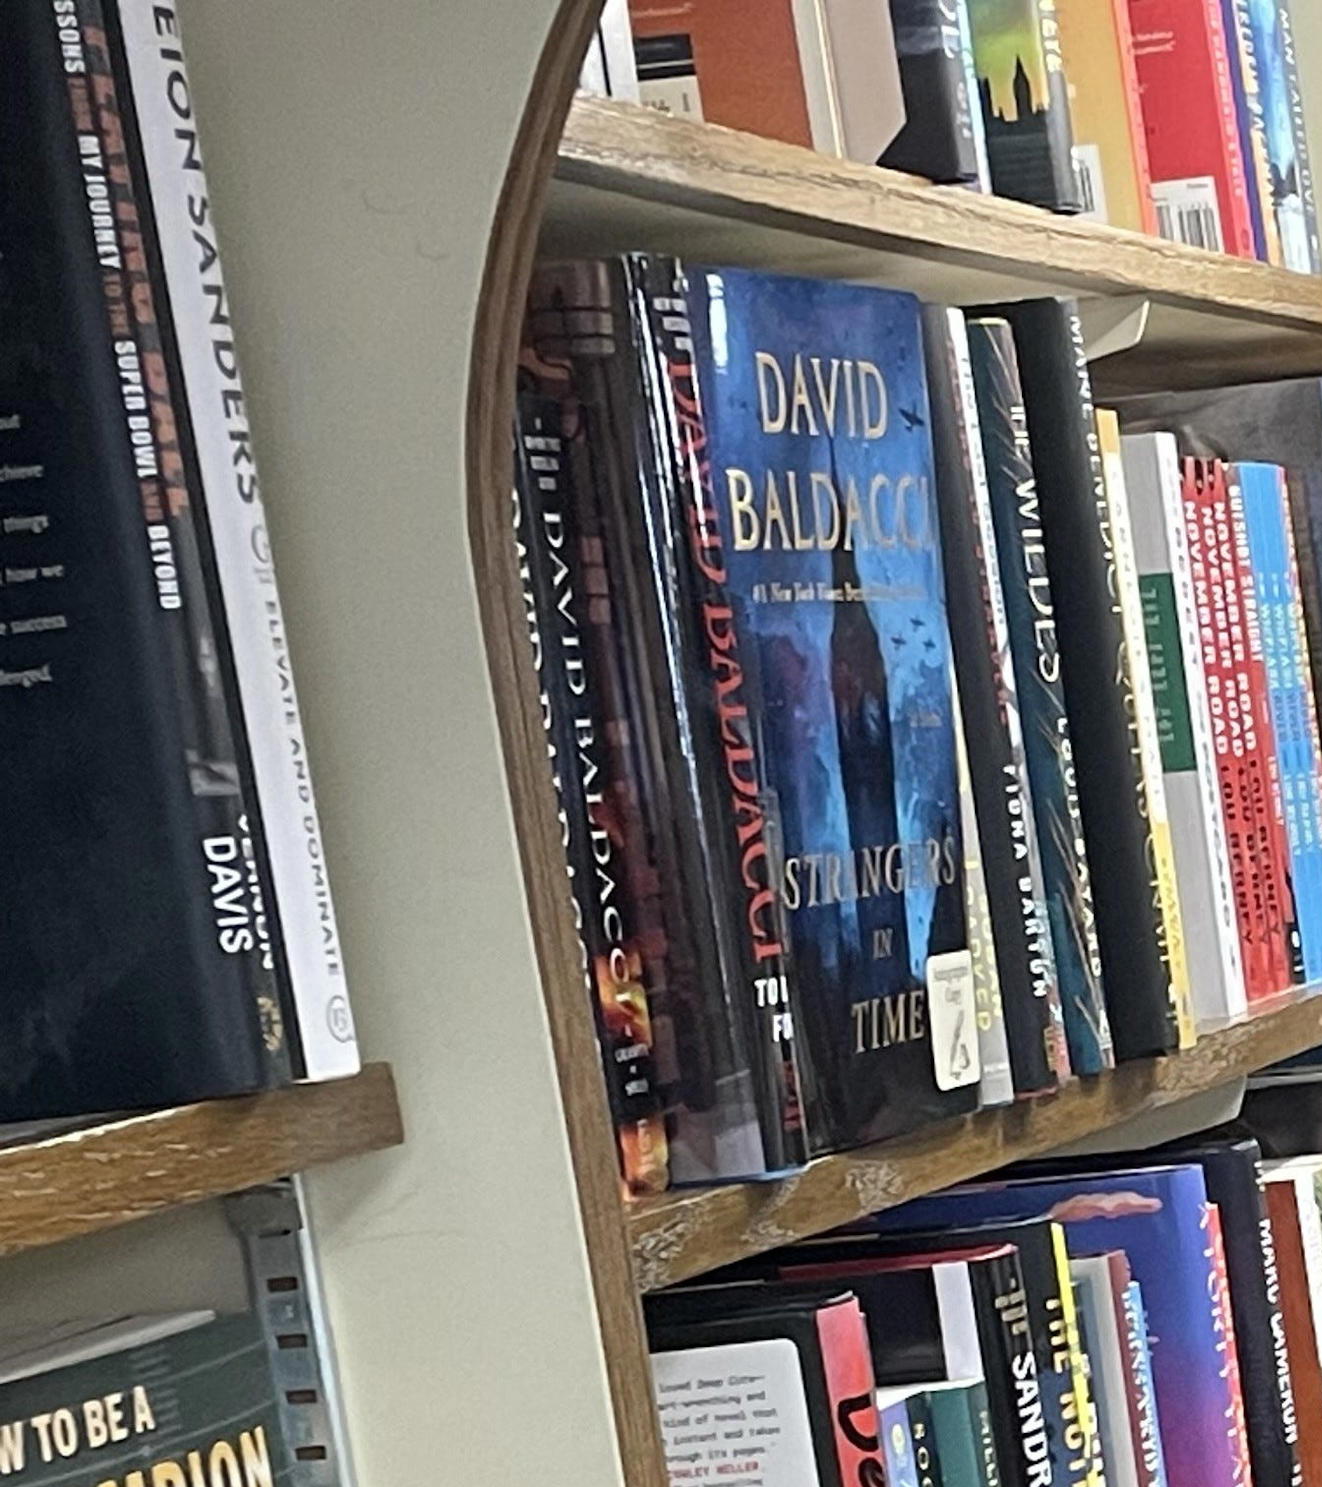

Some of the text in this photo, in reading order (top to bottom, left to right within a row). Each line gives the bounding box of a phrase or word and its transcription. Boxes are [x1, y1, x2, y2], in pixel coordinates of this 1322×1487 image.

[77, 134, 107, 172] MY
[84, 173, 122, 270] JOURNEY
[114, 340, 148, 411] SUPER
[187, 194, 260, 505] SANDERS
[755, 351, 889, 440] DAVID
[127, 415, 158, 479] BOWL
[725, 466, 937, 553] BALDACCI
[147, 525, 183, 610] BEYOND
[1014, 479, 1061, 684] WILDES
[1184, 500, 1218, 666] NOVEMBER
[1207, 676, 1230, 756] ROAD
[1200, 506, 1234, 670] NOVEMBER
[1224, 679, 1244, 758] ROAD
[1213, 500, 1246, 663] NOVEMBER
[1237, 672, 1257, 751] ROAD
[543, 510, 588, 696] DAVID
[574, 716, 636, 1004] BALDACCI
[702, 602, 782, 964] BALDACCI
[202, 835, 255, 955] DAVIS
[783, 836, 957, 911] STRANGERS
[1003, 764, 1050, 999] FIONA BARTON
[872, 926, 894, 961] IN
[850, 992, 925, 1055] TIME
[32, 1407, 79, 1463] TO
[83, 1391, 130, 1449] BE
[133, 1385, 156, 1433] A
